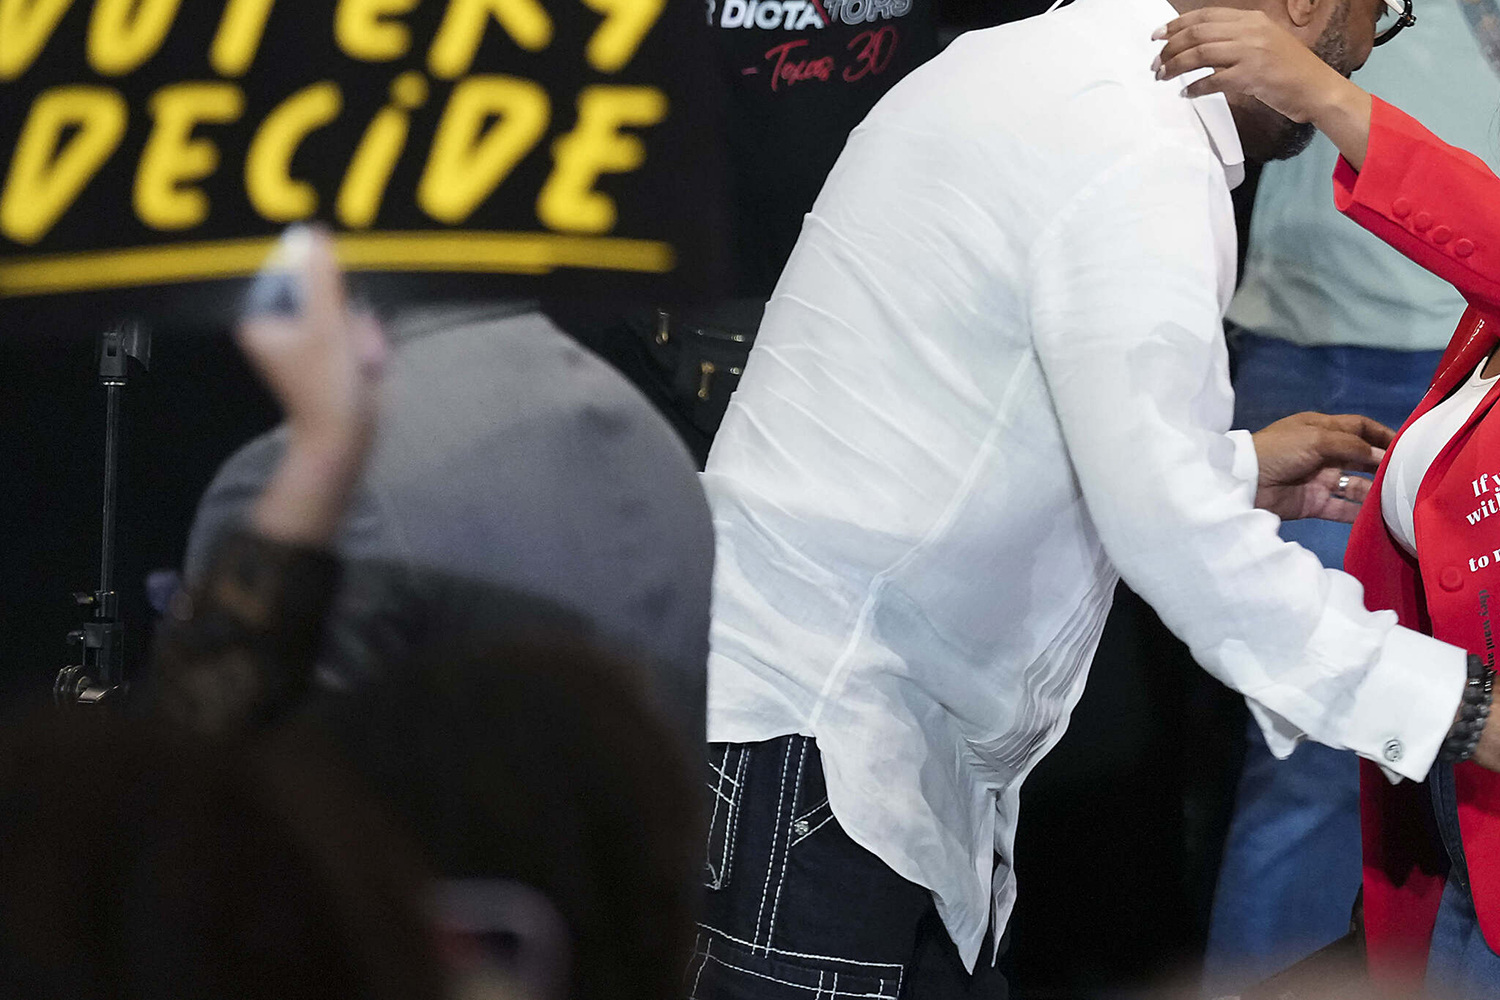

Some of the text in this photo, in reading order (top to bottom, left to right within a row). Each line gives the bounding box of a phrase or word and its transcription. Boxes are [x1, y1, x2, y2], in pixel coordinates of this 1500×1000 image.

[842, 25, 899, 83] 30
[1471, 473, 1489, 498] If
[1468, 554, 1490, 573] to
